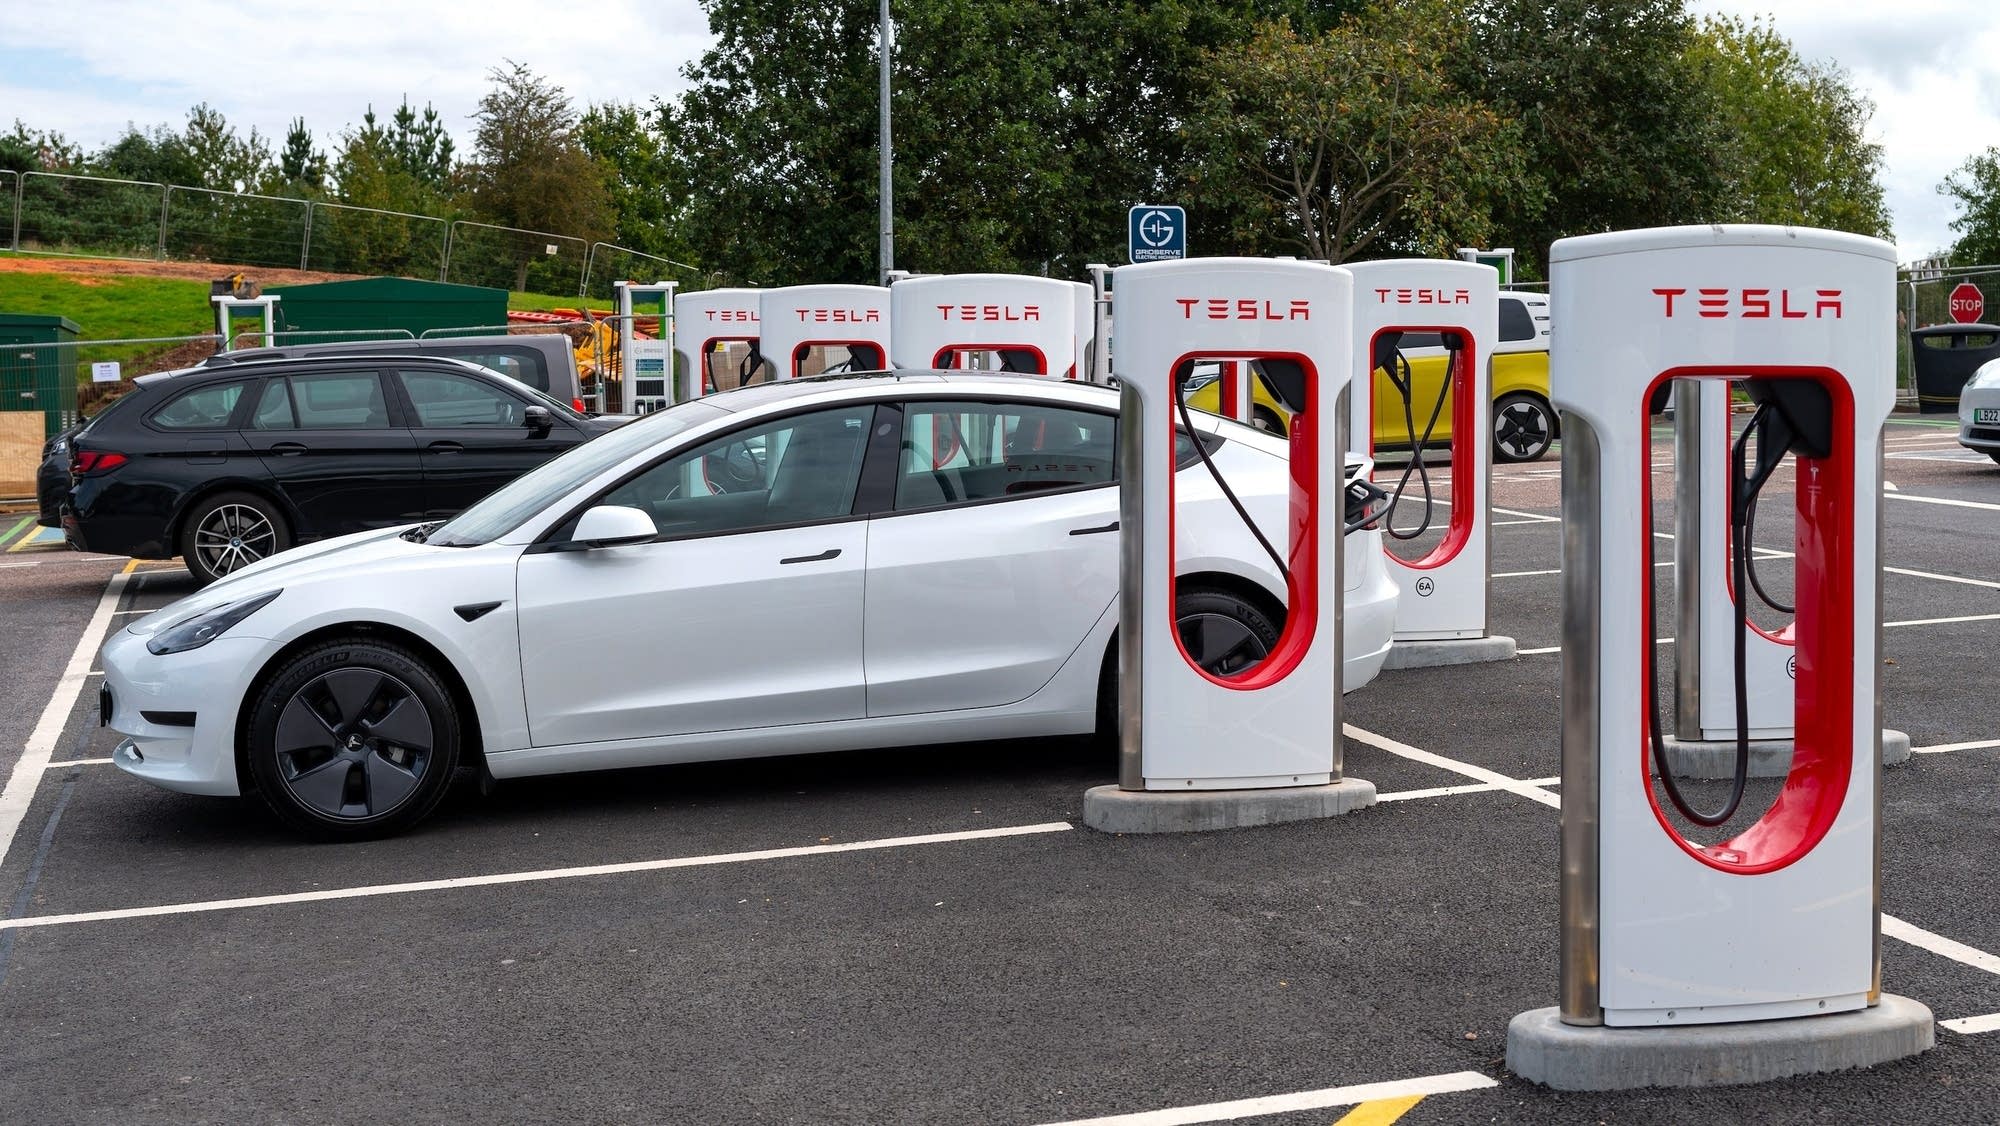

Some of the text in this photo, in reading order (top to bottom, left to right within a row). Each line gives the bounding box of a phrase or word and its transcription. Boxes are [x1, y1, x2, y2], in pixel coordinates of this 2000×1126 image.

[1375, 288, 1470, 305] TESLA
[1651, 288, 1843, 319] TESLA
[1951, 299, 1982, 311] STOP
[705, 311, 760, 321] TESL
[795, 310, 879, 322] TESLA
[937, 306, 1039, 321] TESLA
[1176, 299, 1311, 321] TESLA
[1979, 410, 1999, 422] LB22
[1418, 582, 1431, 591] 6A
